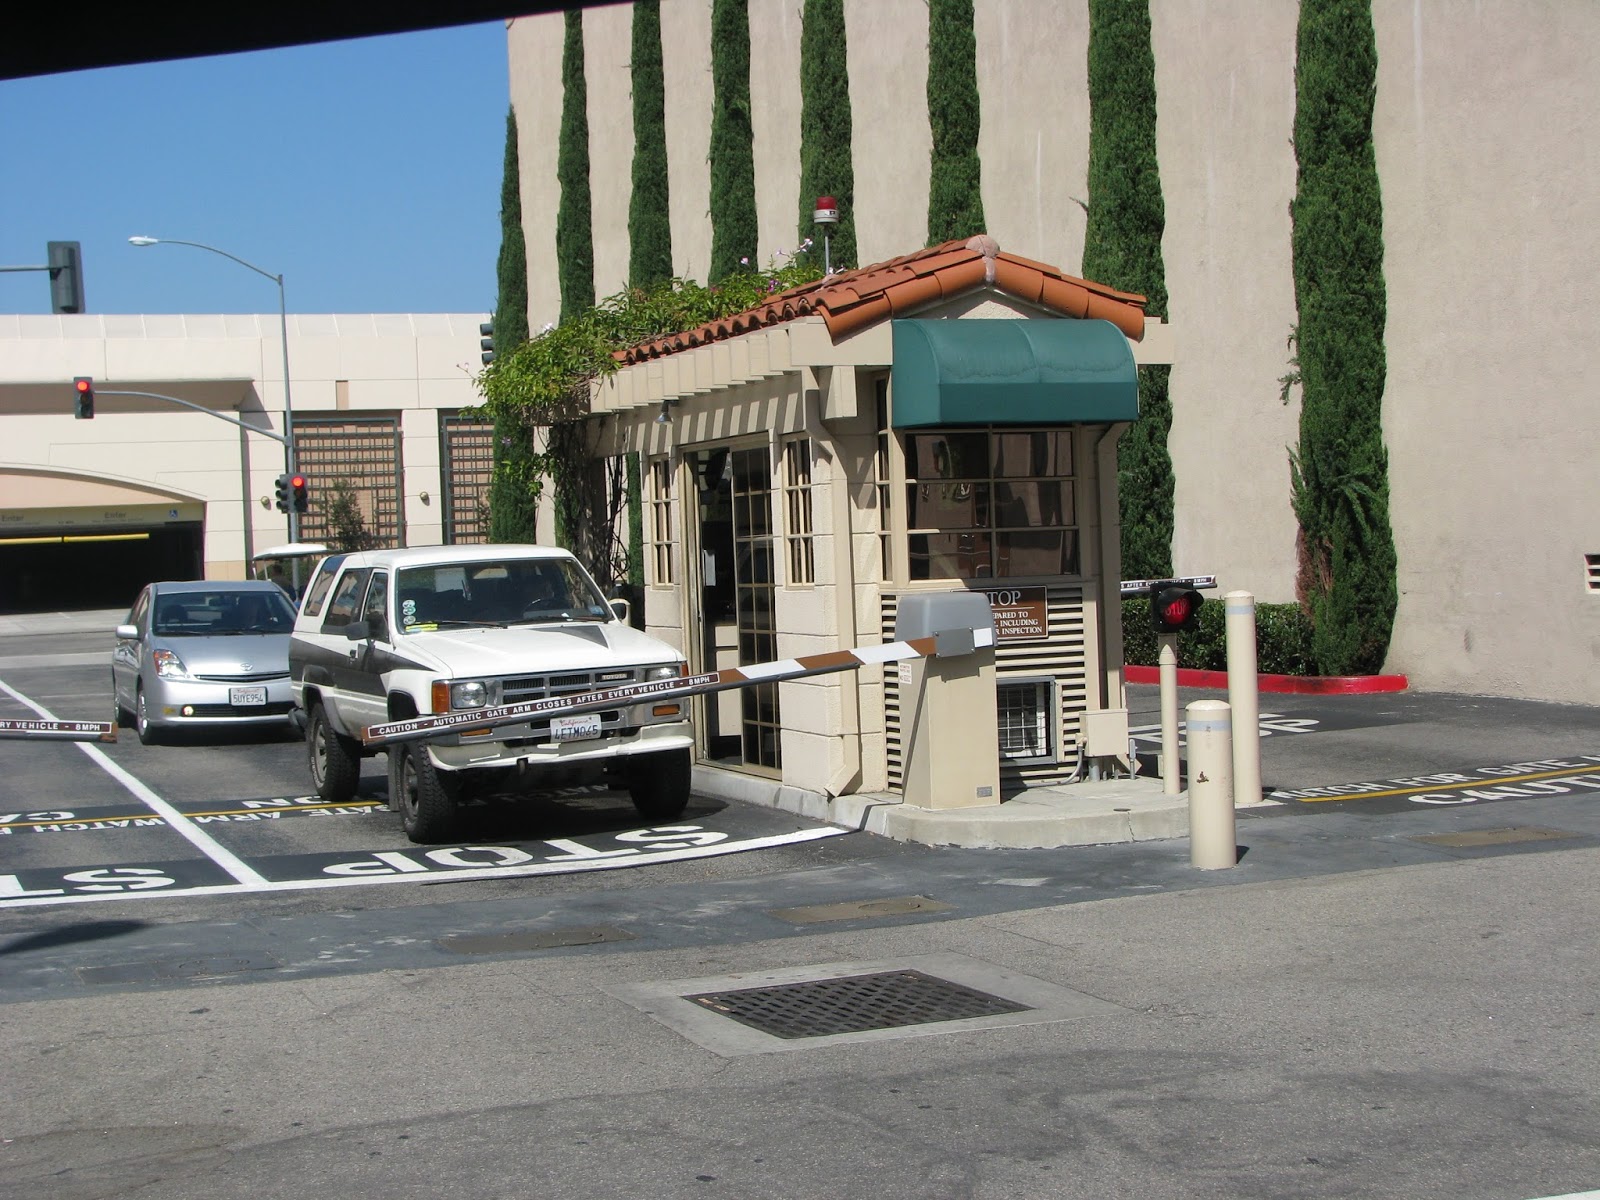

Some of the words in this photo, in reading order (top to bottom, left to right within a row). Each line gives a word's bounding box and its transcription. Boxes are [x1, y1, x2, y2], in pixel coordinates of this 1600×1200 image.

[986, 590, 1021, 606] TOP
[1165, 599, 1188, 616] STOP
[1000, 619, 1038, 627] INCLUDING
[1002, 626, 1042, 635] INSPECTION
[379, 723, 418, 735] CAUTION
[433, 712, 482, 727] AUTOMATIC
[487, 709, 508, 718] GATE
[513, 705, 531, 714] ARM
[536, 698, 572, 710] CLOSES
[576, 693, 603, 704] AFTER
[608, 687, 635, 698] EVERY
[638, 681, 675, 693] VEHICLE
[688, 676, 710, 685] 8MPH
[16, 722, 58, 730] VEHICLE
[1388, 773, 1483, 787] FOR
[1476, 760, 1590, 776] GATE
[196, 811, 281, 824] ARM
[33, 818, 167, 833] WATCH
[322, 825, 728, 876] STOP
